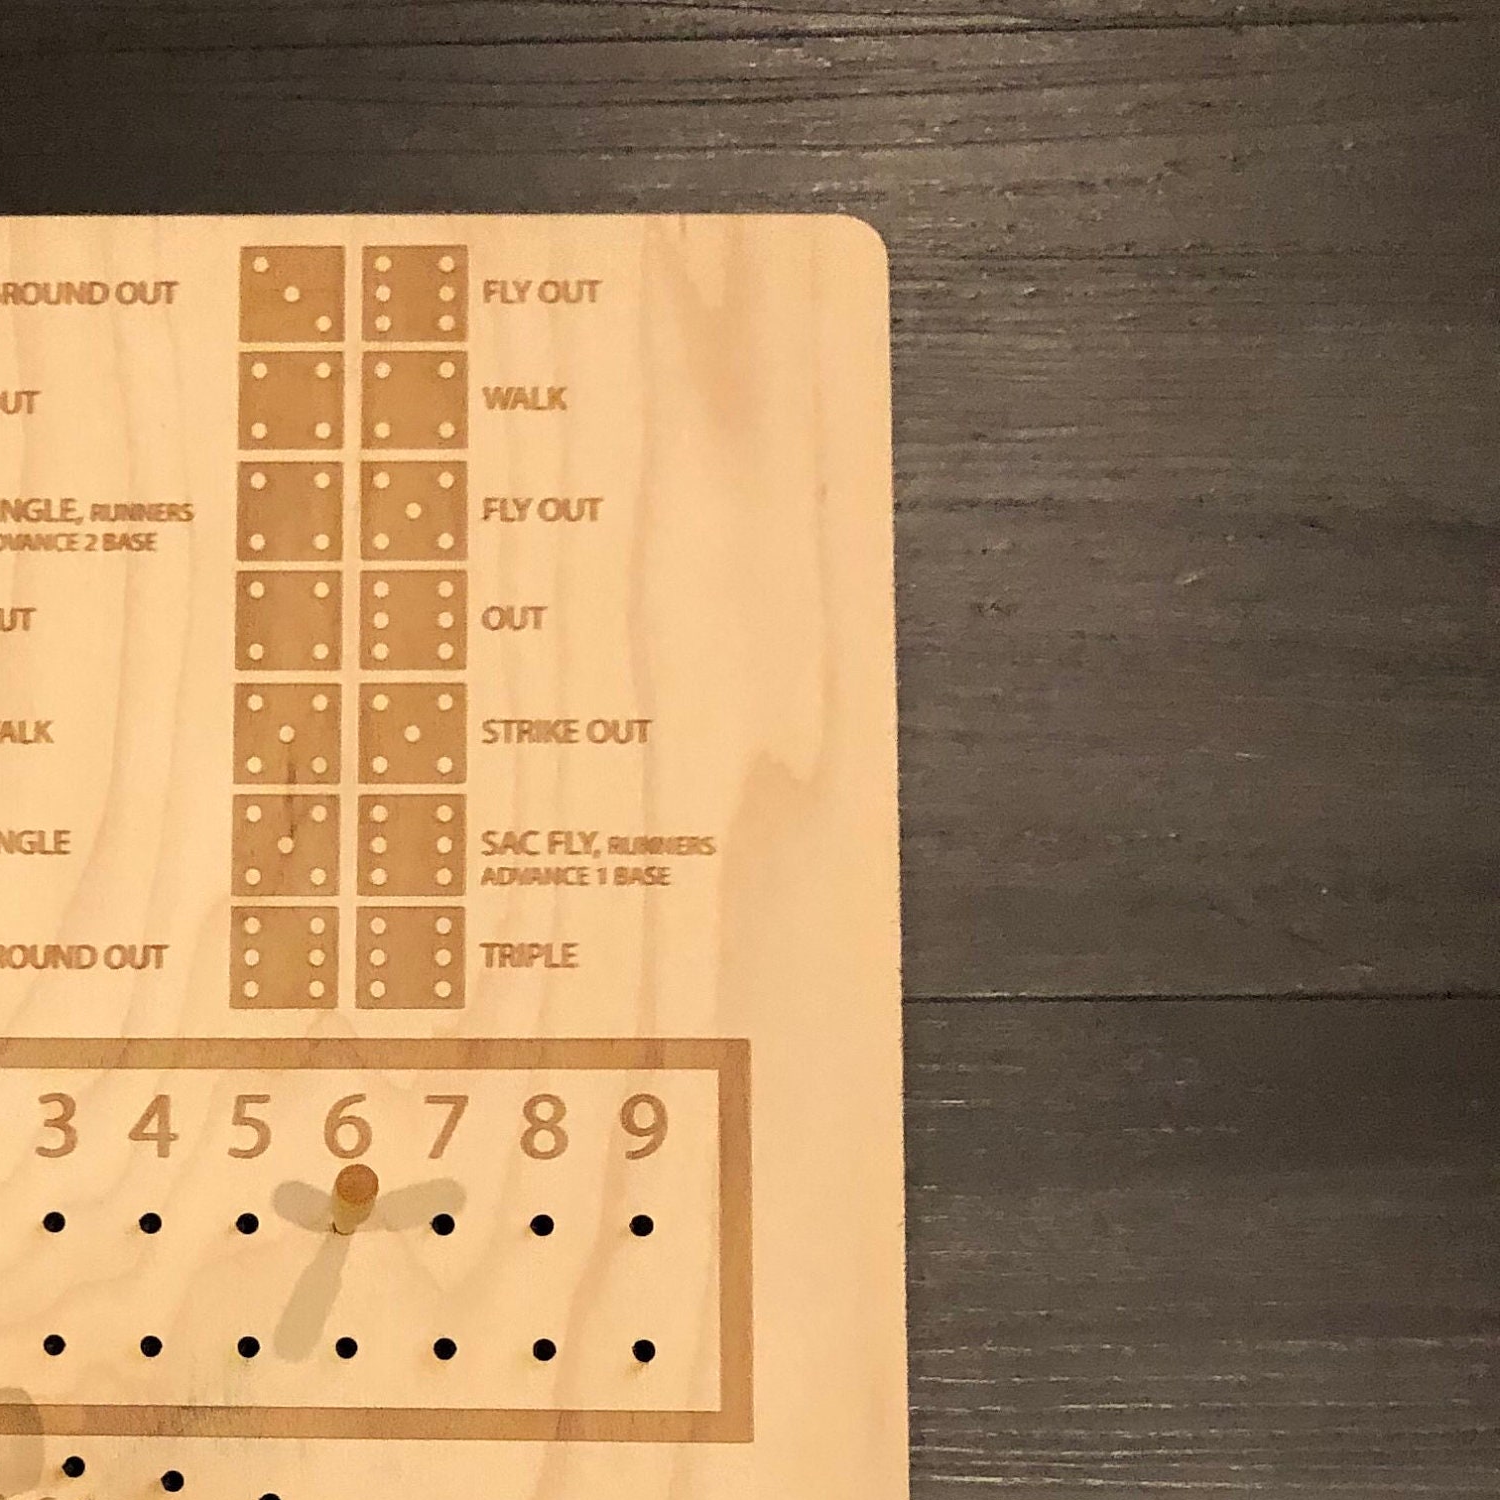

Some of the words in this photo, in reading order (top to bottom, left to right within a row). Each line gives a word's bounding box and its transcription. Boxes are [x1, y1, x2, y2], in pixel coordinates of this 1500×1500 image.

[115, 281, 179, 305] OUT
[483, 280, 532, 303] FLY
[540, 280, 600, 303] OUT
[483, 387, 567, 411] WALK
[91, 503, 194, 522] RUNNERS
[483, 498, 532, 522] FLY
[538, 498, 603, 522] OUT
[84, 533, 98, 551] 2
[103, 533, 157, 551] BASE
[482, 606, 547, 631] OUT
[482, 719, 579, 745] STRIKE
[586, 720, 652, 745] OUT
[481, 830, 541, 856] SAC
[547, 830, 601, 858] FLY,
[607, 836, 717, 856] RUNNERS
[481, 867, 592, 886] ADVANCE
[598, 867, 607, 886] 1
[614, 867, 671, 886] BASE
[104, 944, 169, 970] OUT
[481, 942, 579, 968] TRIPLE
[35, 1093, 79, 1159] 3
[128, 1094, 178, 1159] 4
[227, 1093, 272, 1160] 5
[323, 1093, 373, 1160] 6
[424, 1094, 469, 1160] 7
[519, 1093, 570, 1161] 8
[619, 1093, 668, 1161] 9
